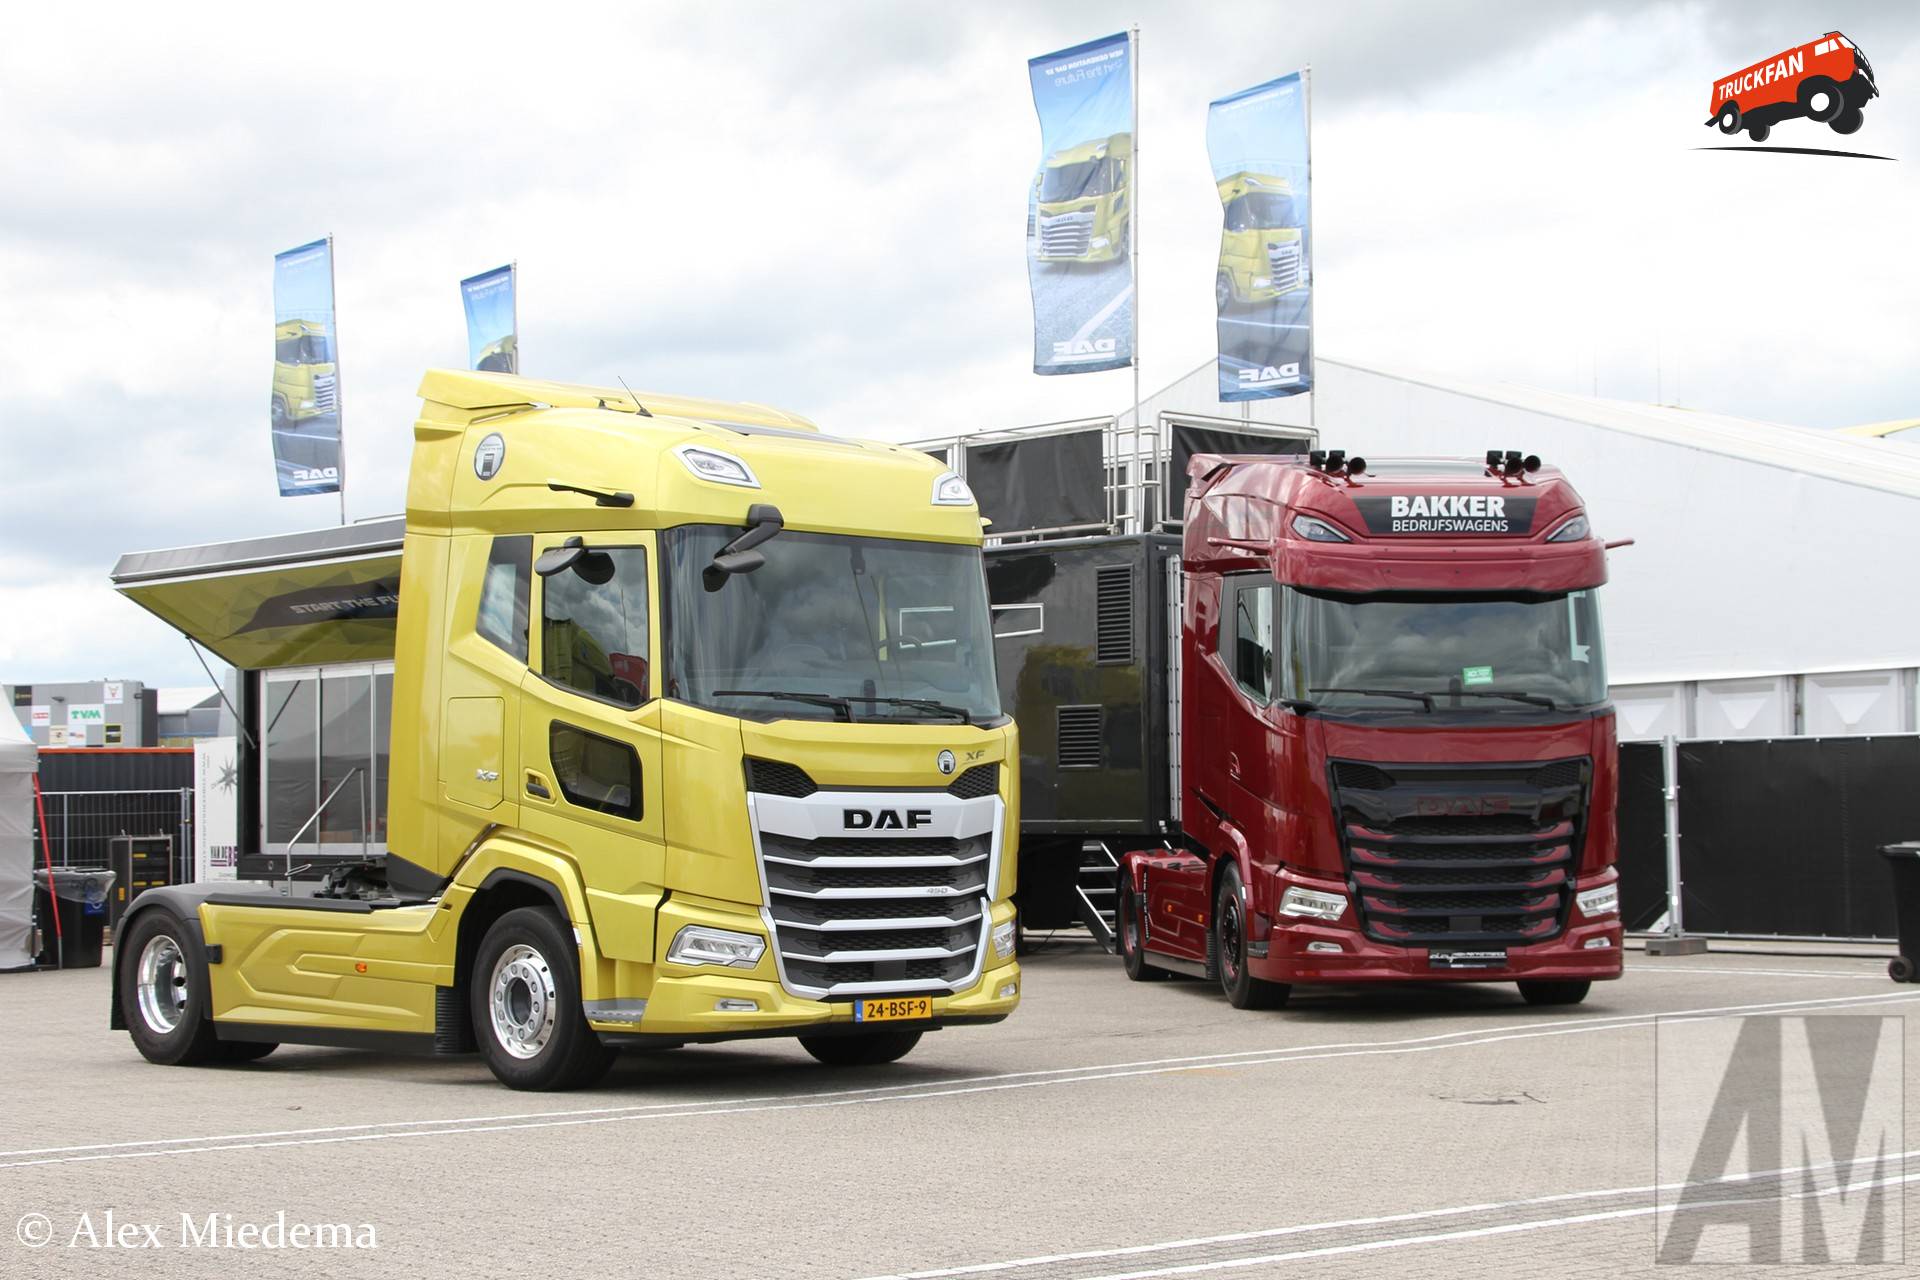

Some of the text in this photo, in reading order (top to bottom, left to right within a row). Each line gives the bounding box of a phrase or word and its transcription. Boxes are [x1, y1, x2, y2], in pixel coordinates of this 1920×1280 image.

[1391, 496, 1506, 517] BAKKER
[1392, 519, 1509, 532] BEDRIJFSWAGENS
[289, 601, 342, 614] START
[342, 597, 379, 609] THE
[71, 709, 101, 719] TVM
[965, 750, 985, 760] XF
[476, 768, 499, 781] XF
[843, 809, 933, 831] DAF
[868, 1000, 927, 1018] 24-BSF-9
